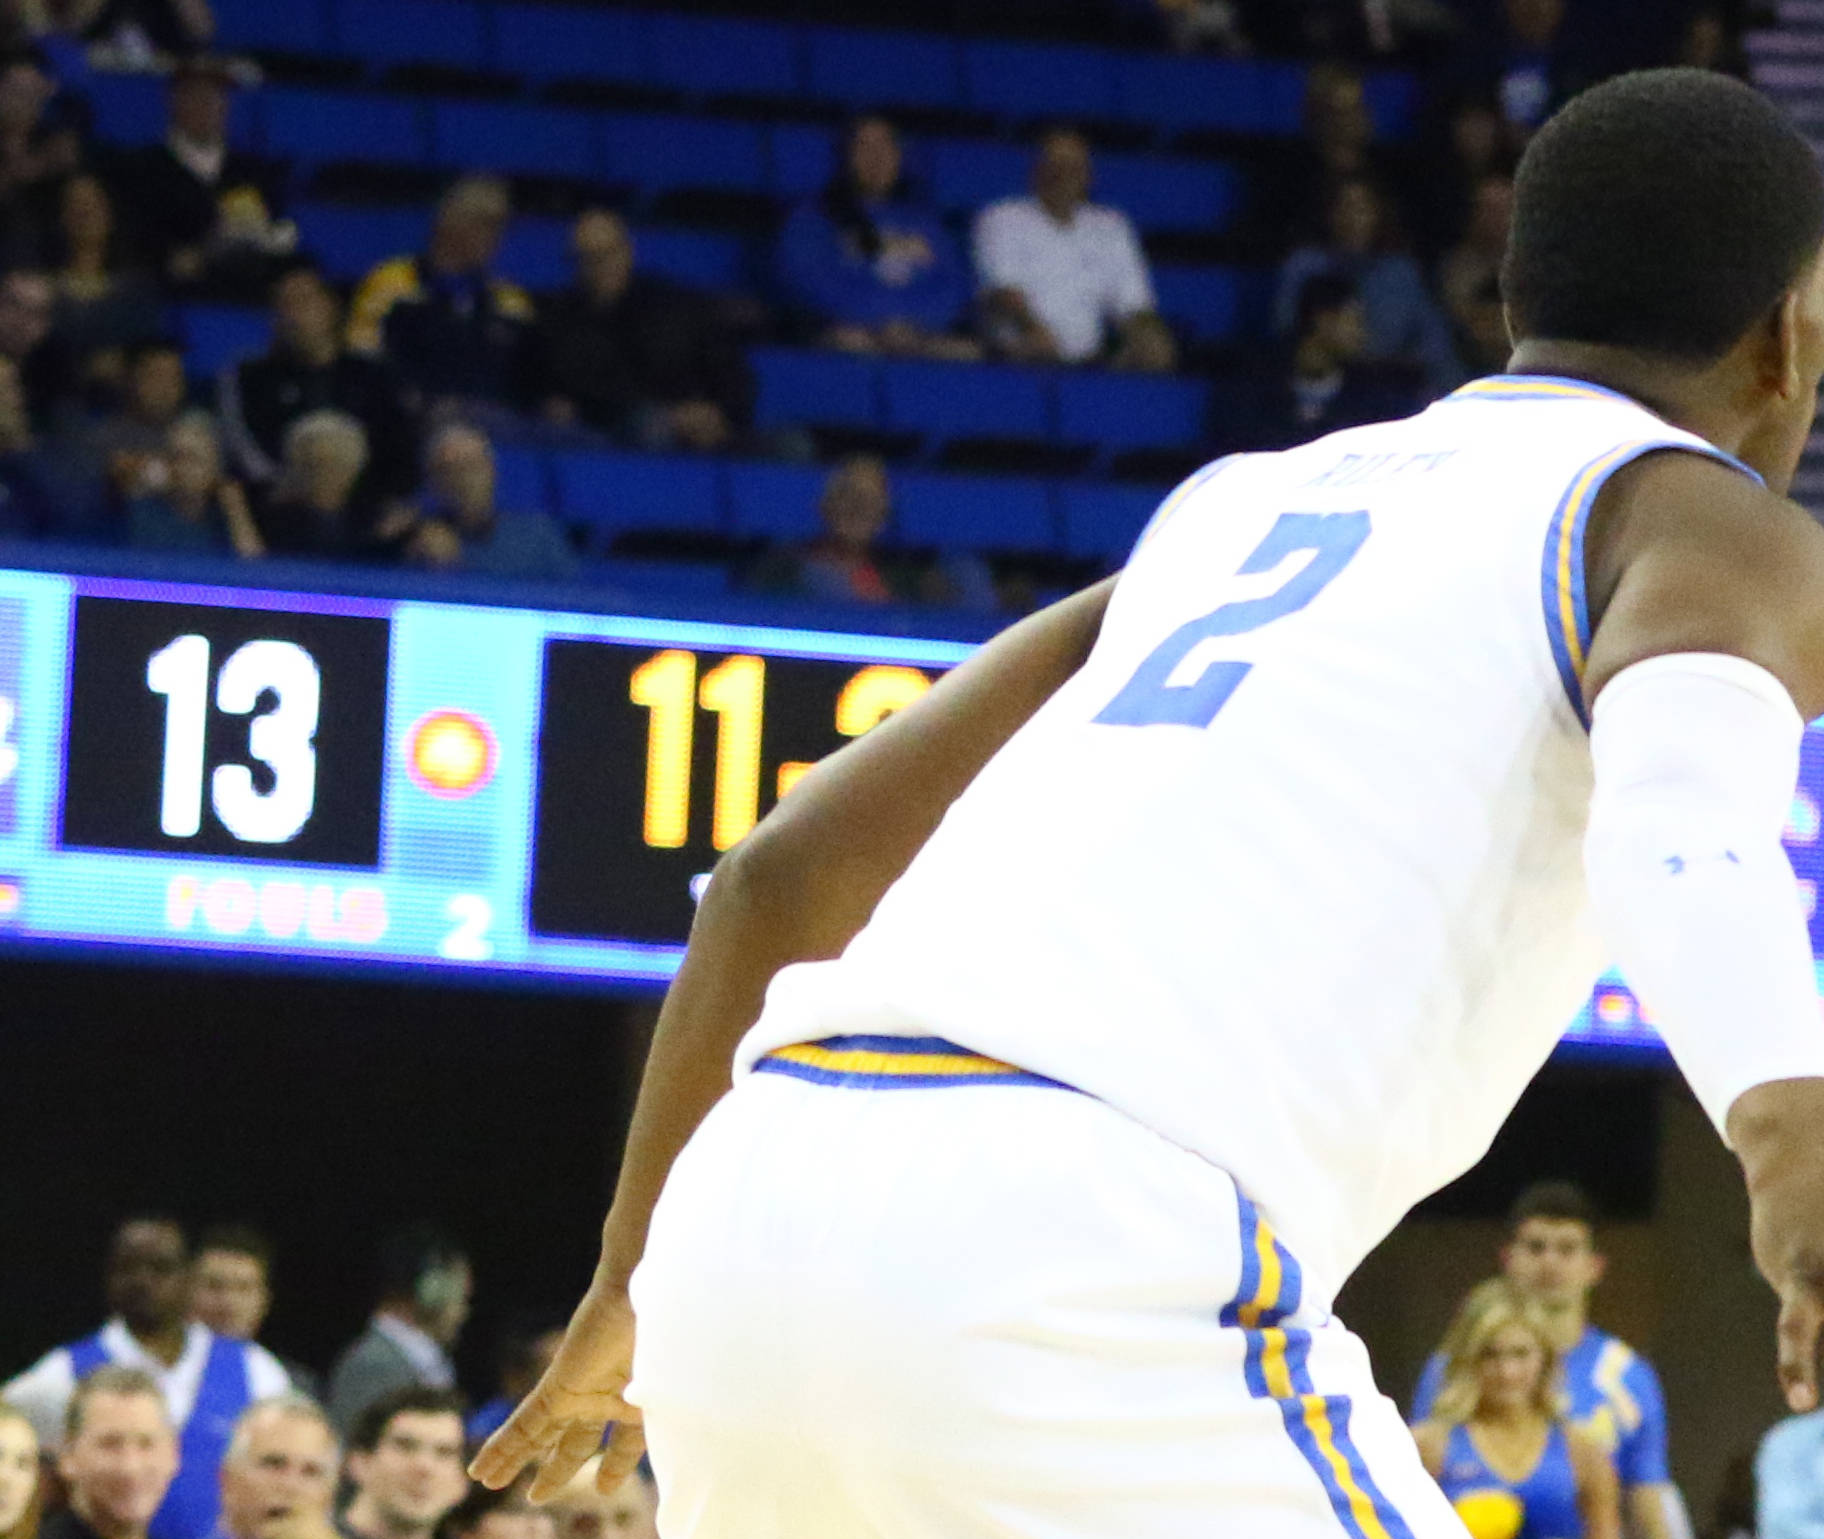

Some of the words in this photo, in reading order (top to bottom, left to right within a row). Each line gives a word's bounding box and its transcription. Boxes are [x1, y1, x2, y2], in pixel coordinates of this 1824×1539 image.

[1091, 509, 1372, 729] 2
[147, 633, 321, 843] 13
[438, 894, 493, 960] 2
